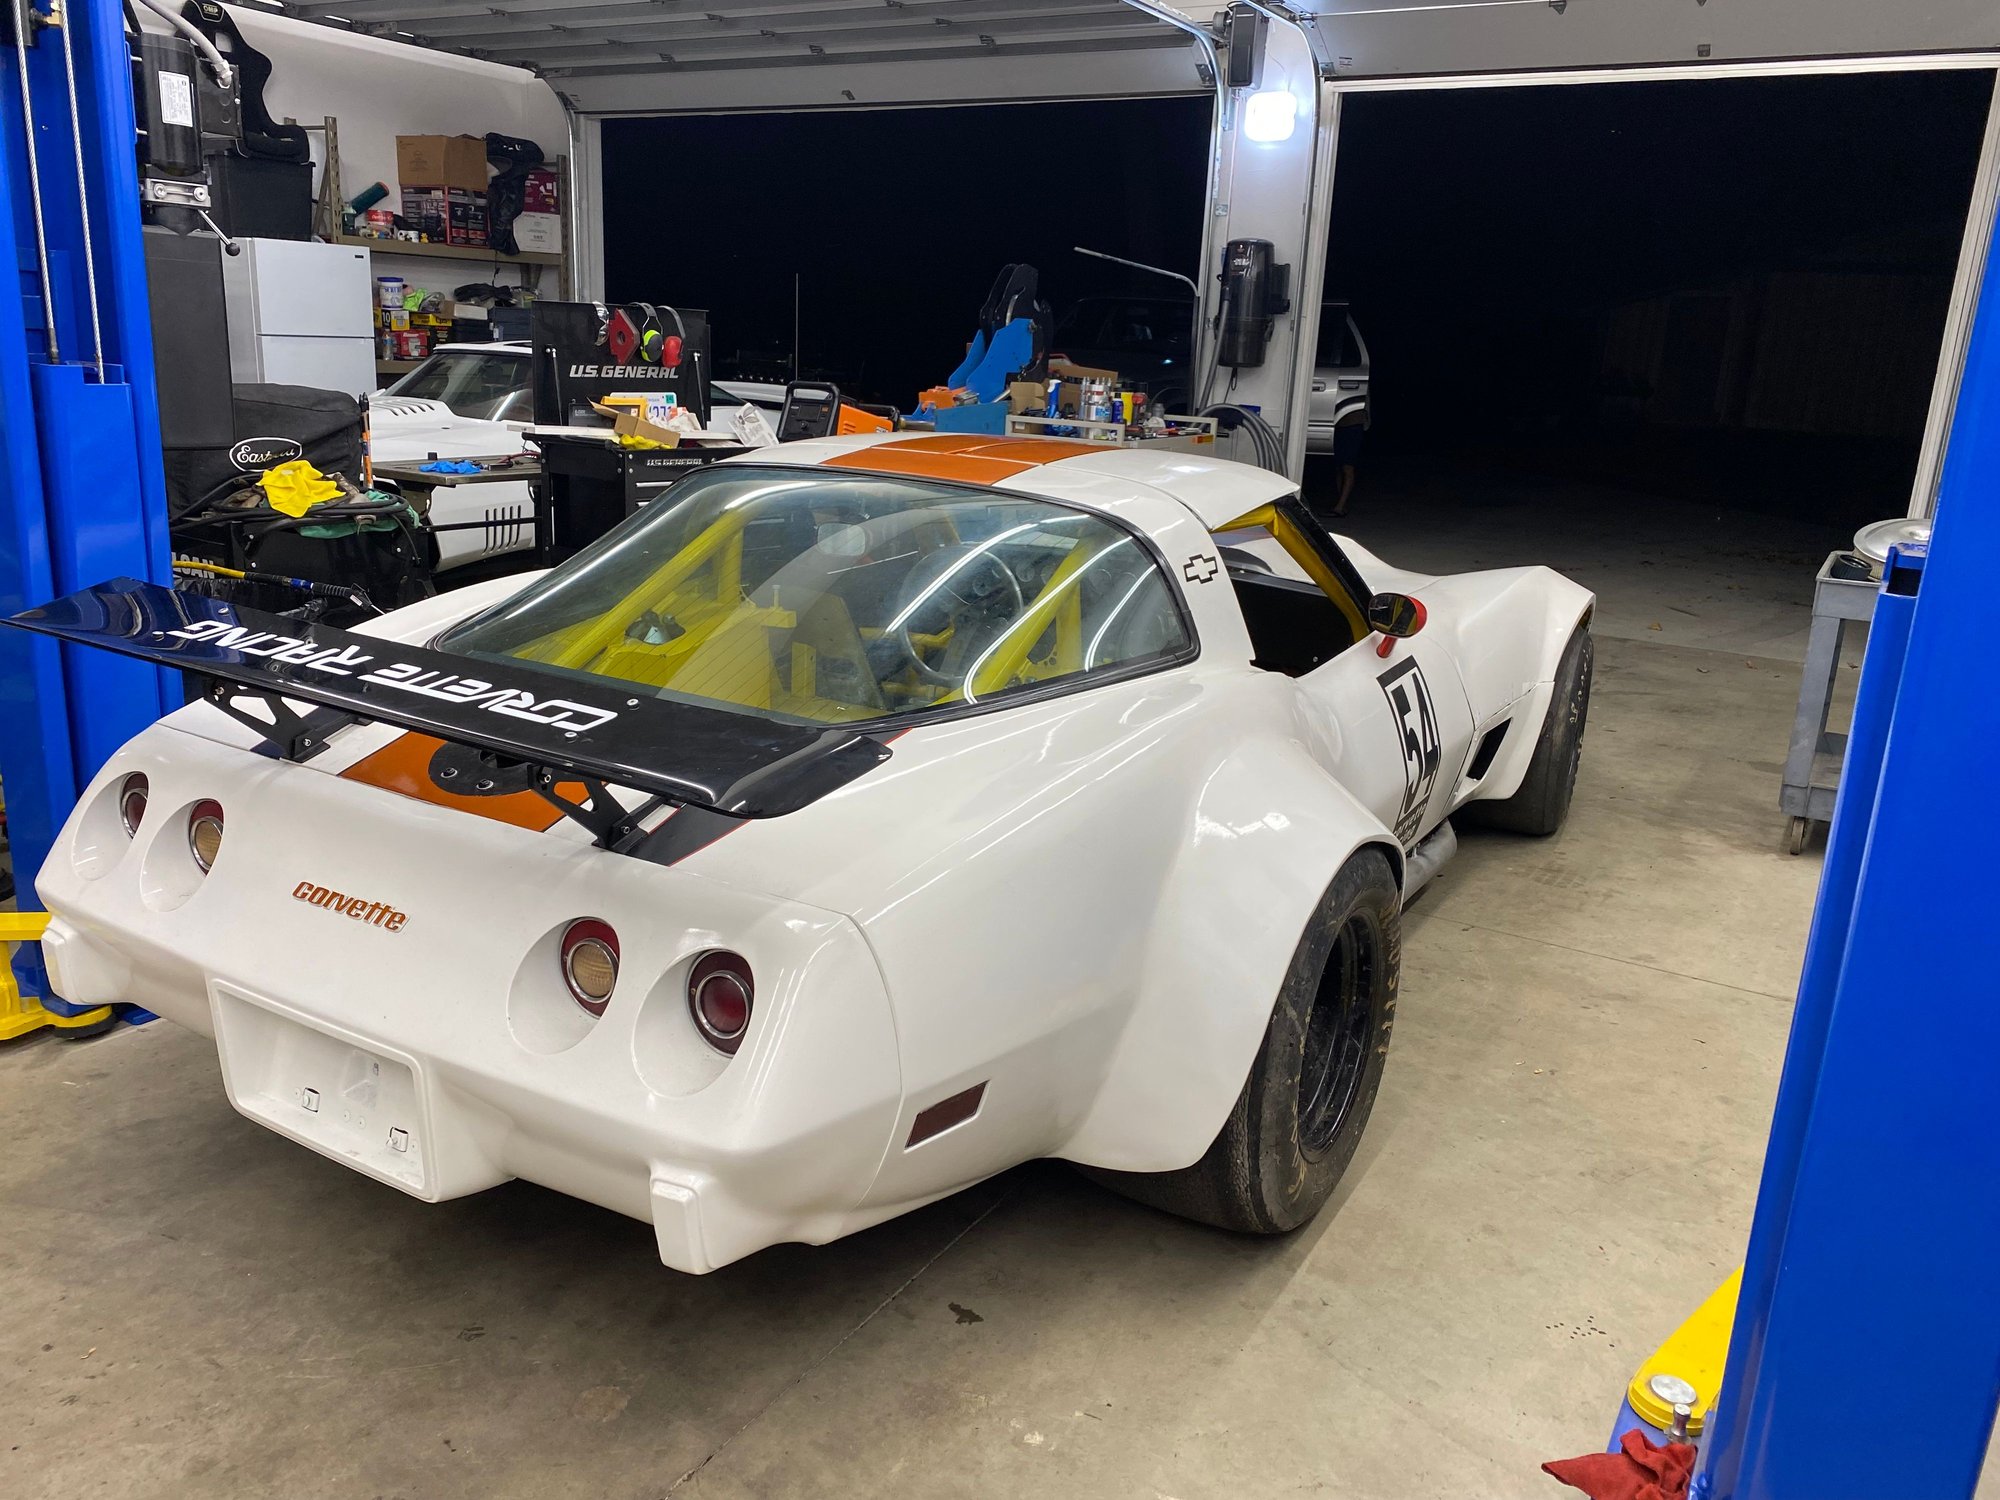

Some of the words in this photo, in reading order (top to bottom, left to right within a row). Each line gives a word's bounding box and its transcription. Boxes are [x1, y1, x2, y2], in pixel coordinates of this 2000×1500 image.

[600, 365, 680, 379] GENERAL
[166, 620, 374, 675] RACING
[356, 663, 618, 732] CORVETTE
[1391, 672, 1439, 814] 54
[292, 881, 409, 932] corvette
